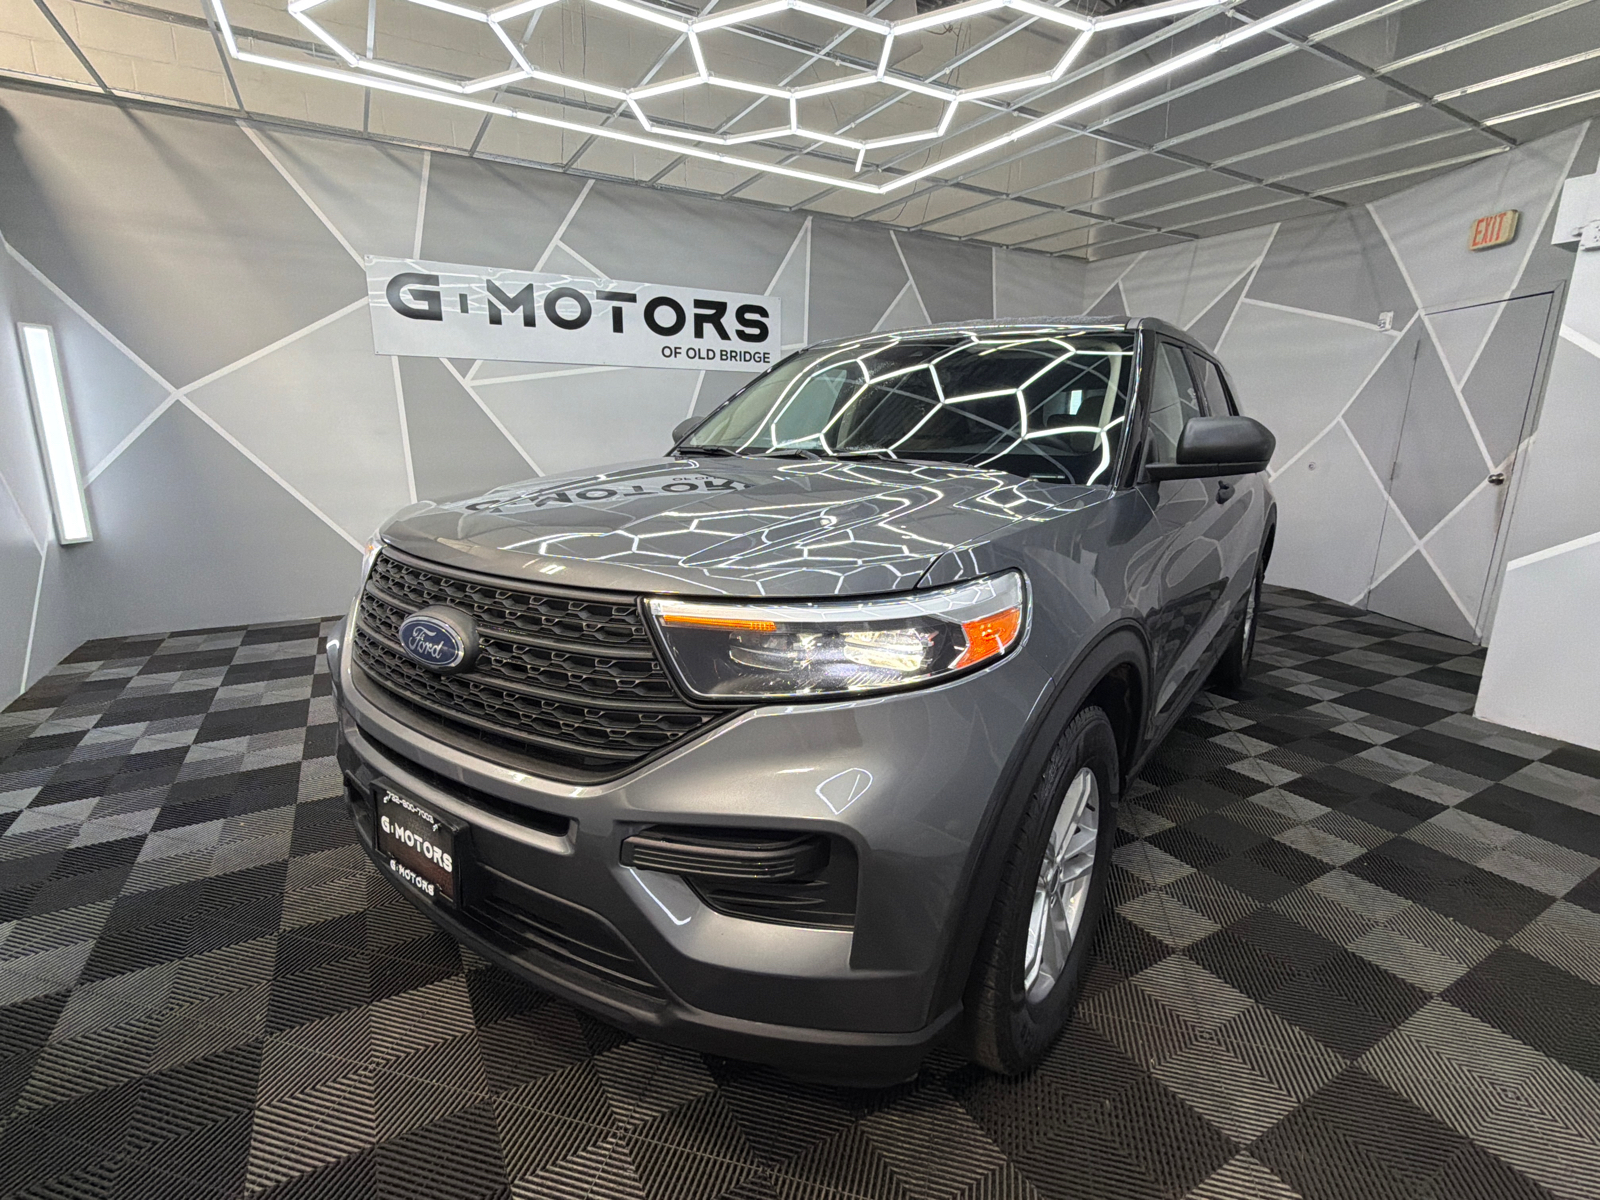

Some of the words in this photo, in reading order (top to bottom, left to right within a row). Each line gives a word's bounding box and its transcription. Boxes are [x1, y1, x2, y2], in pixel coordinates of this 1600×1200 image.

[1471, 212, 1507, 247] EXIT
[661, 345, 682, 359] OF
[686, 347, 716, 361] OLD
[719, 349, 771, 364] BRIDGE
[408, 625, 445, 659] Ford
